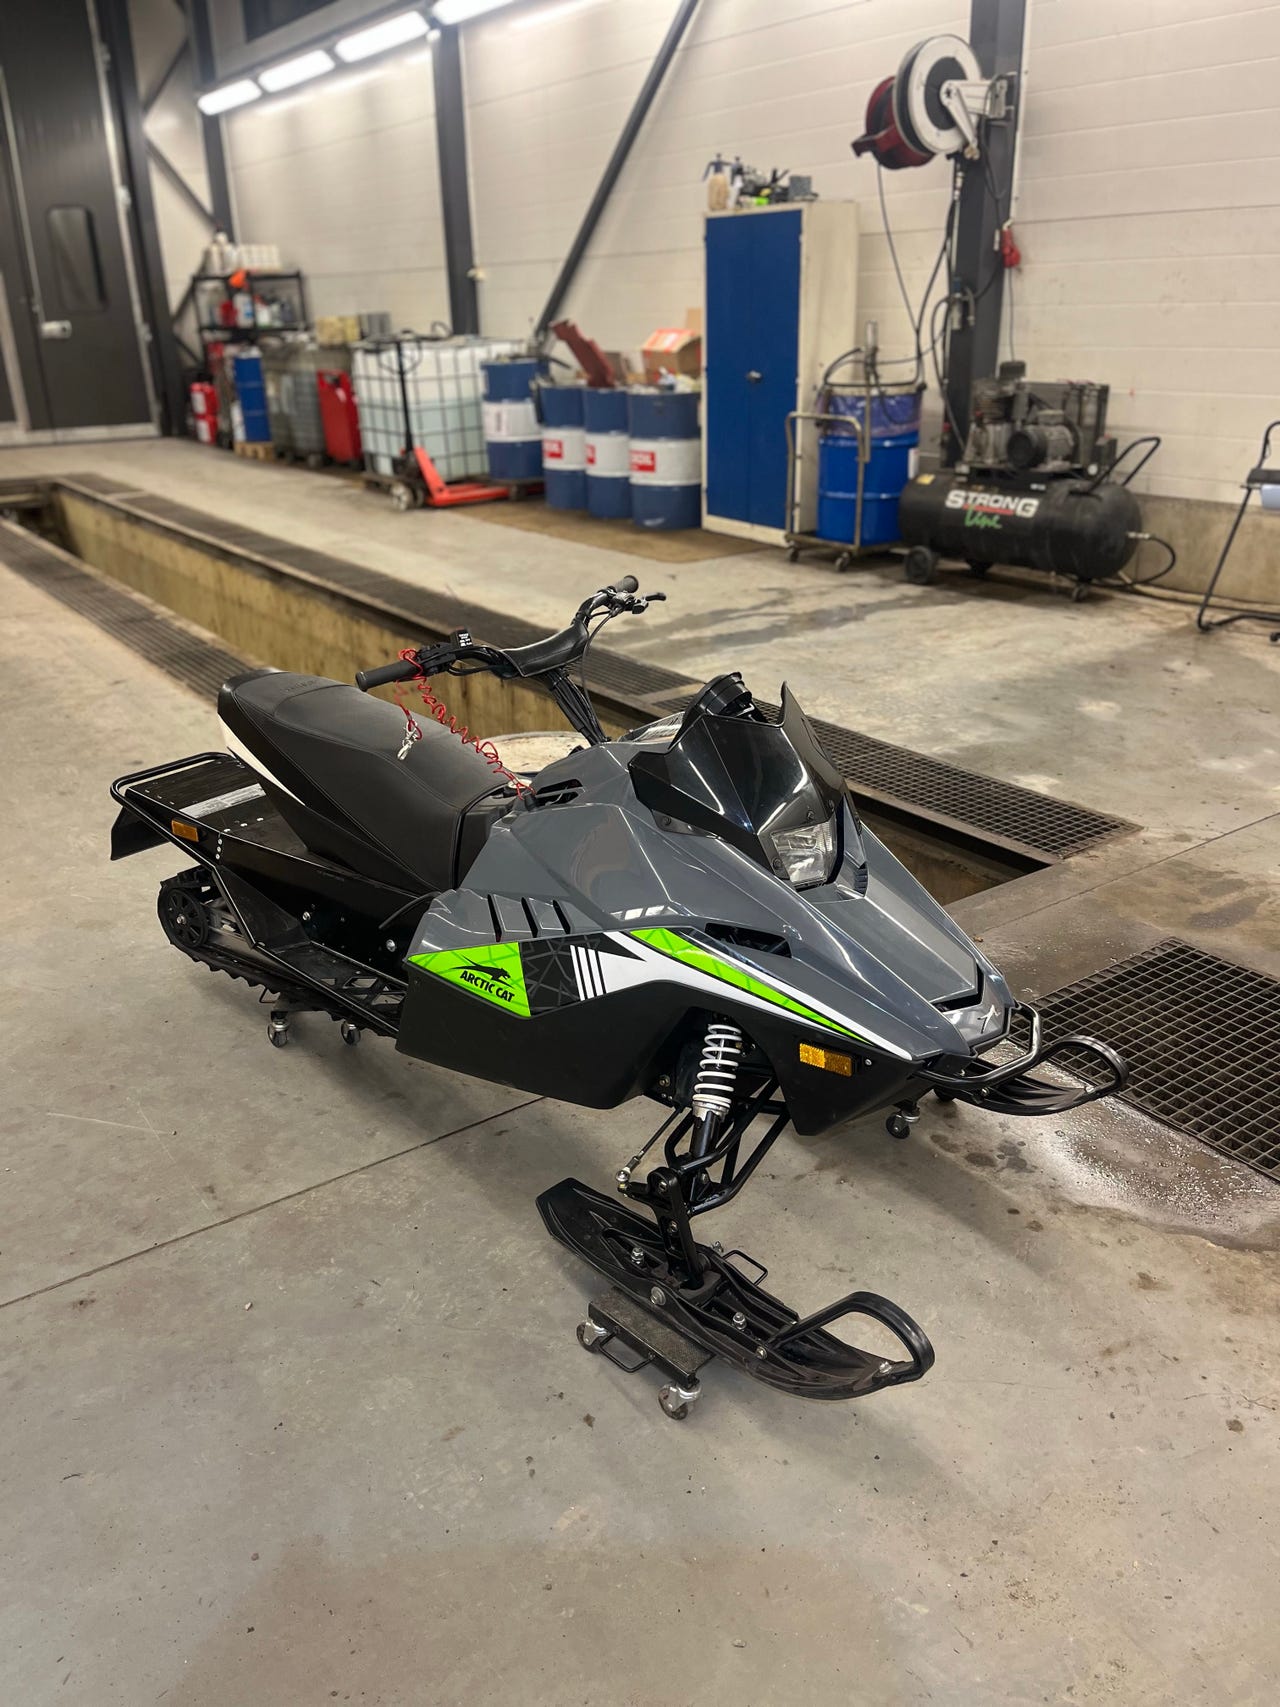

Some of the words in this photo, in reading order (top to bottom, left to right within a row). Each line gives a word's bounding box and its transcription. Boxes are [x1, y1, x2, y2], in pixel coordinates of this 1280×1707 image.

[945, 489, 1039, 518] STRONG
[460, 970, 495, 993] ARCTIC
[495, 987, 515, 1002] CAT
